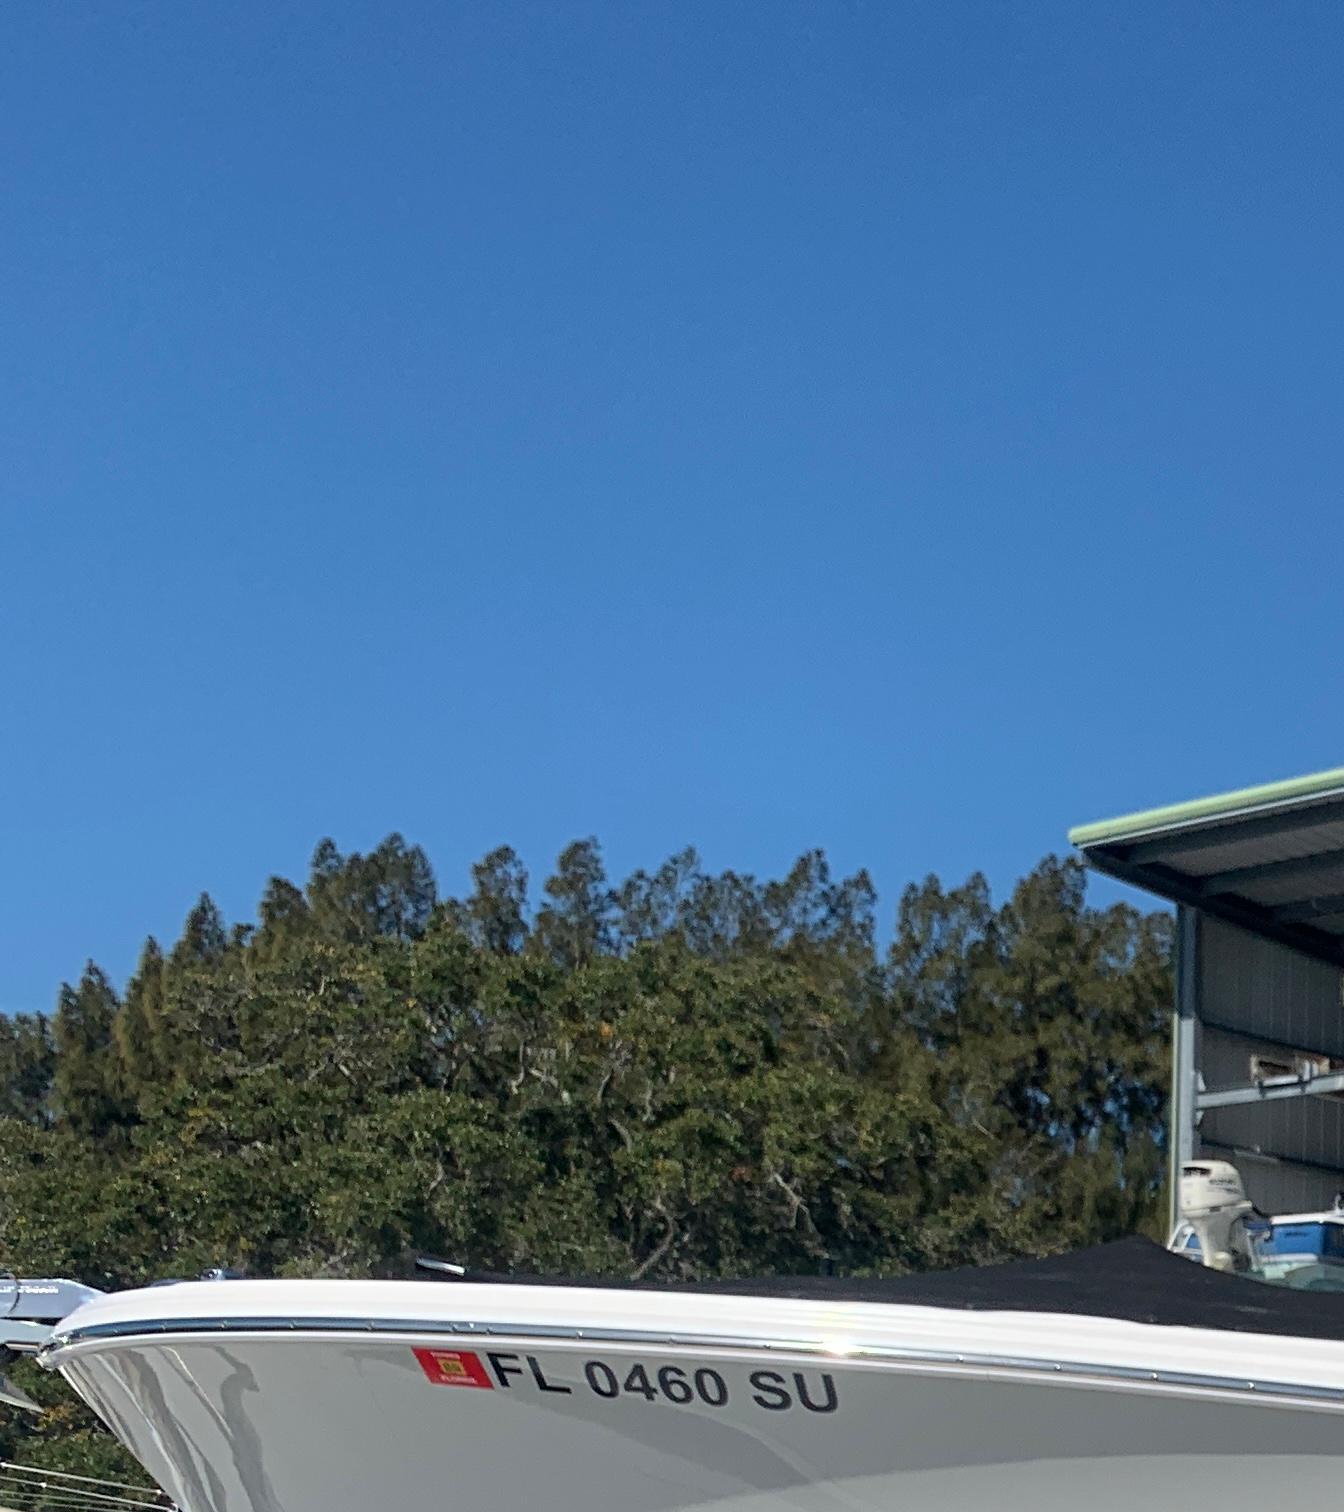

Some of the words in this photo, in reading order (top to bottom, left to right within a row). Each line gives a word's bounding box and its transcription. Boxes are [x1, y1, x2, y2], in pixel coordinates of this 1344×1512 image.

[487, 1352, 573, 1394] FL
[585, 1360, 729, 1407] 0460
[750, 1370, 840, 1413] SU
